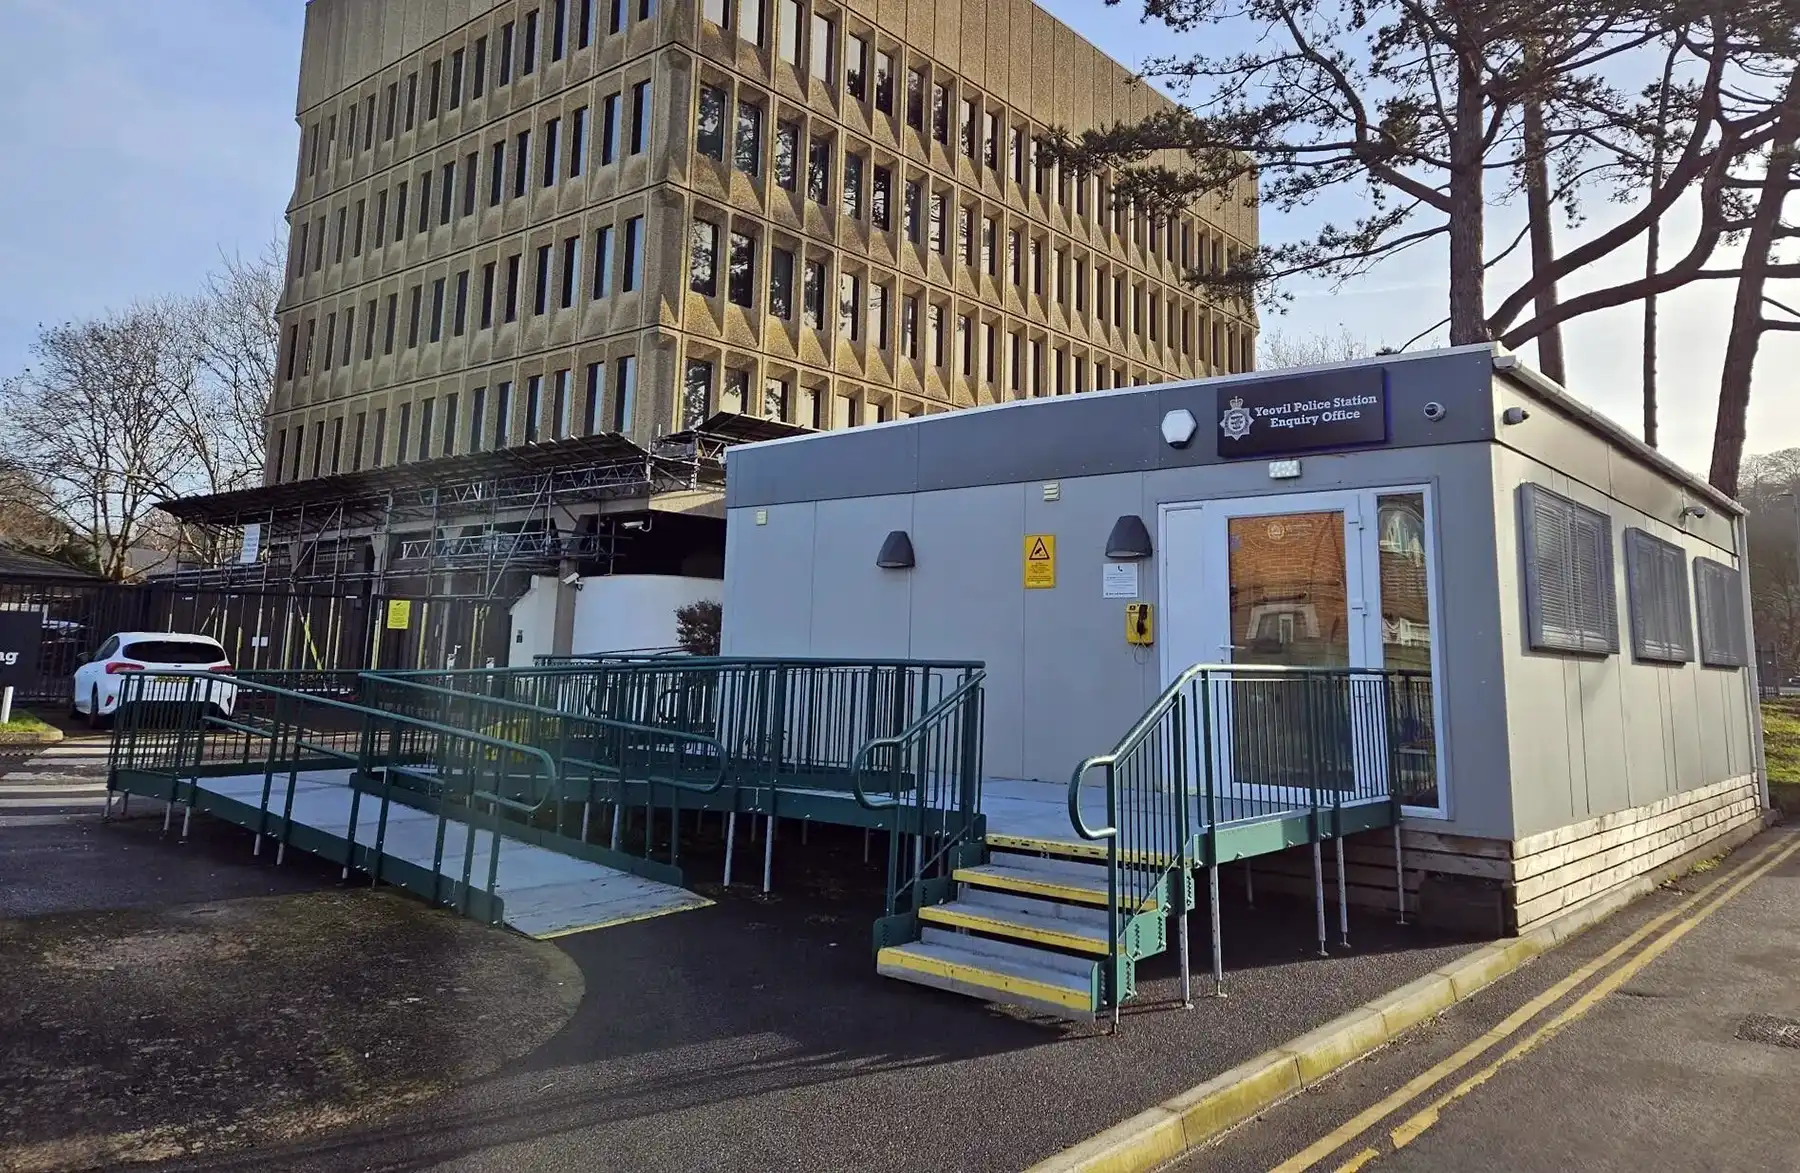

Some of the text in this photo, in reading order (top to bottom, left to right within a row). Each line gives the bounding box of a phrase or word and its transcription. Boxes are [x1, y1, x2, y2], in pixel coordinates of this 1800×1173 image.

[1254, 395, 1377, 417] Yeovil Police Station
[1270, 409, 1360, 428] Enquiry Office
